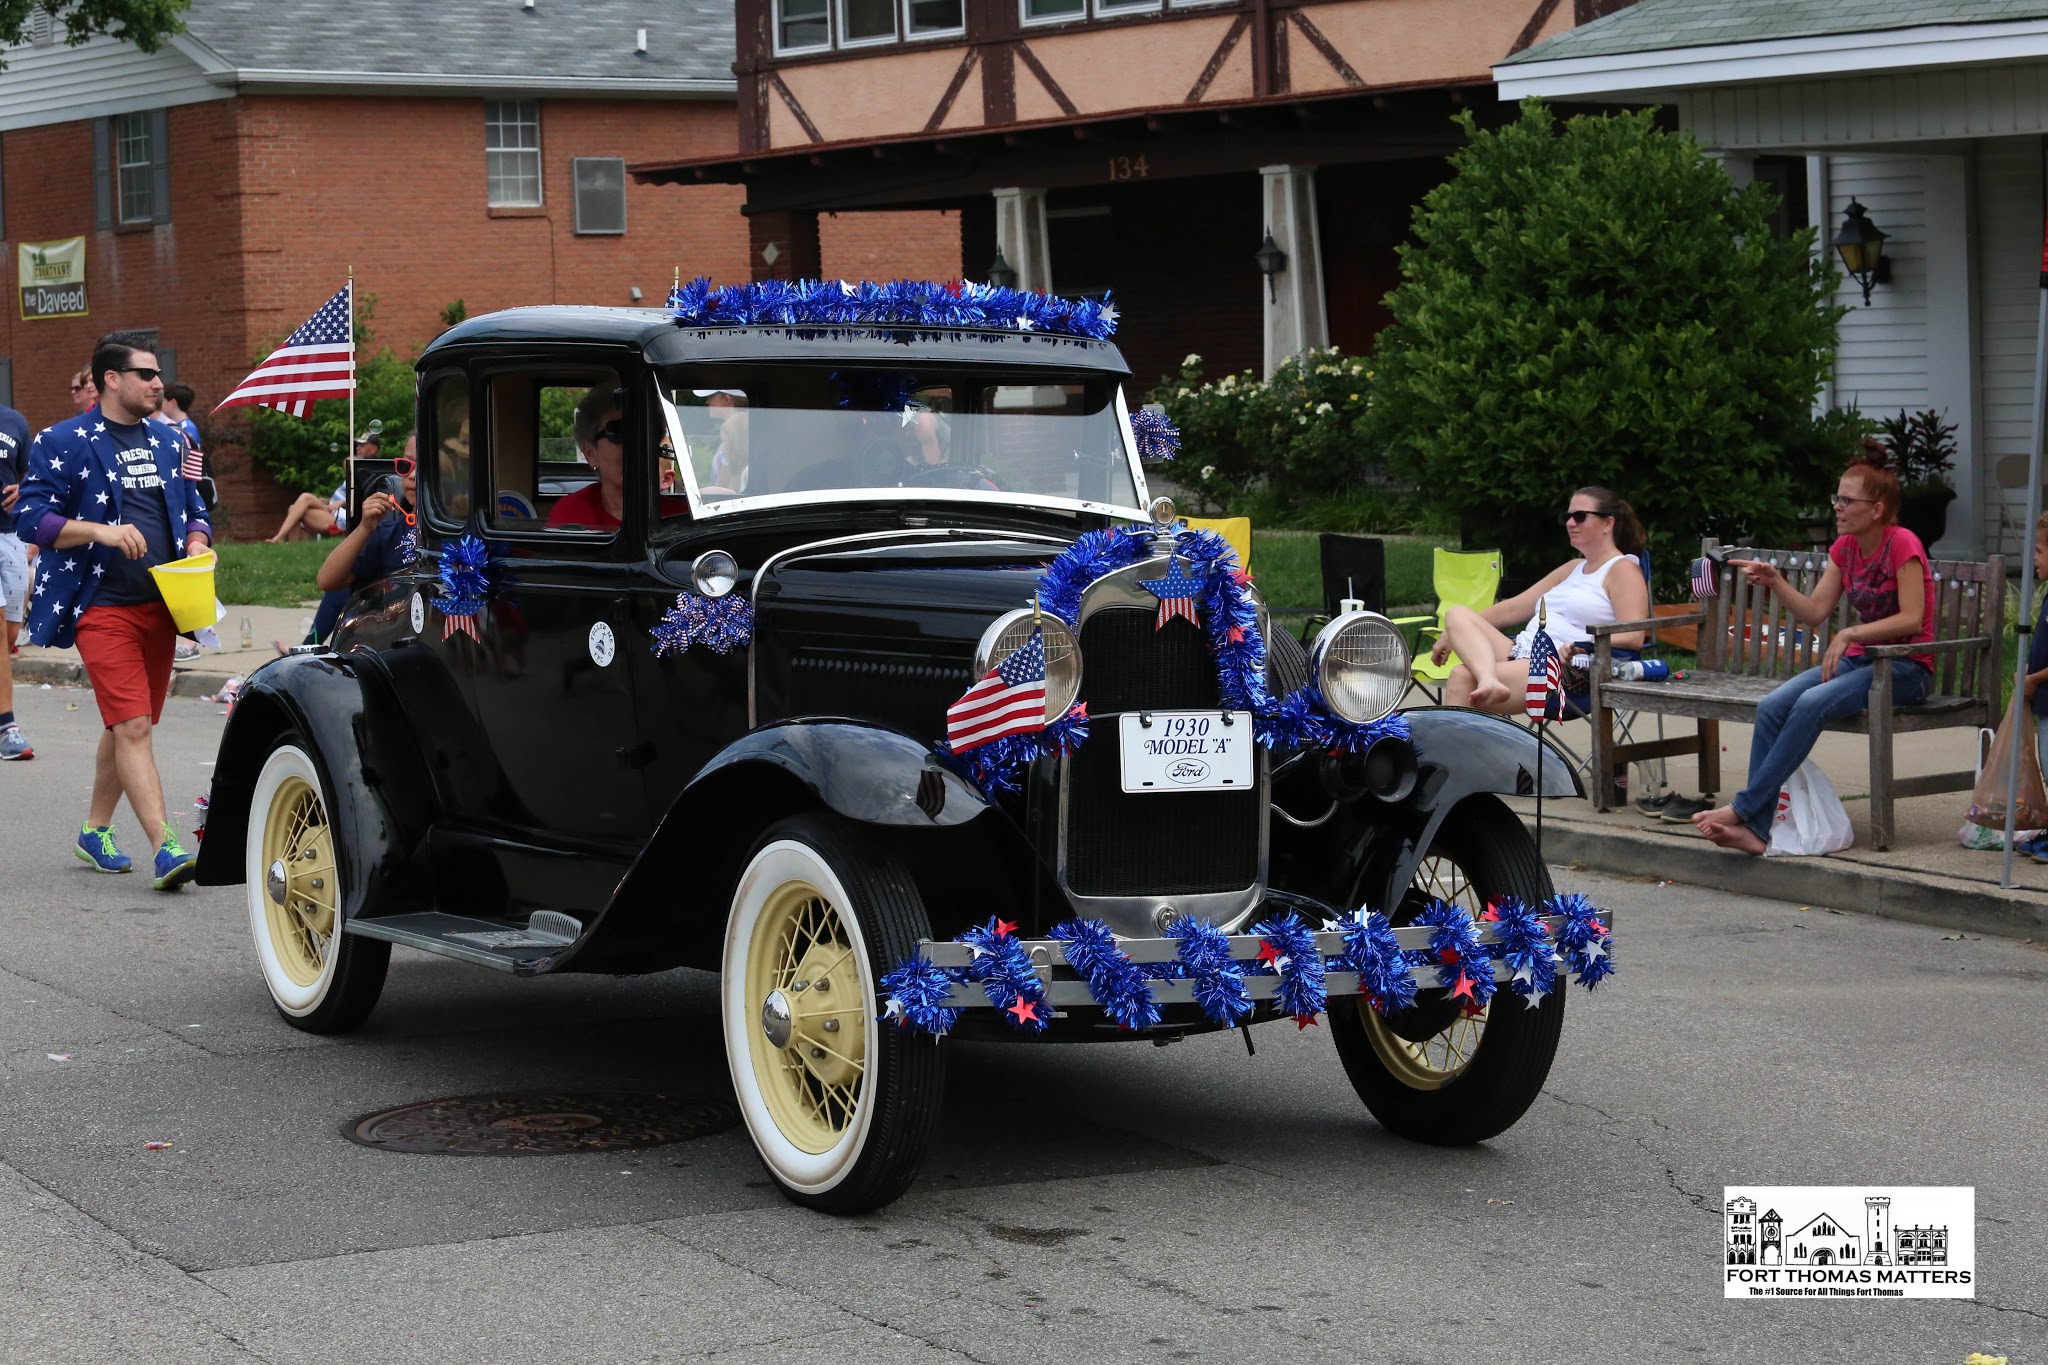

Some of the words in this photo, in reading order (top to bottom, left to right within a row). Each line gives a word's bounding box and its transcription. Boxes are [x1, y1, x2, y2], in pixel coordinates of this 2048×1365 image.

[1108, 153, 1149, 181] 134
[24, 291, 37, 306] the
[37, 284, 84, 314] Daveed
[1163, 718, 1210, 737] 1930
[1144, 738, 1208, 755] MODEL
[1212, 738, 1232, 754] "A"
[1172, 762, 1205, 777] Ford
